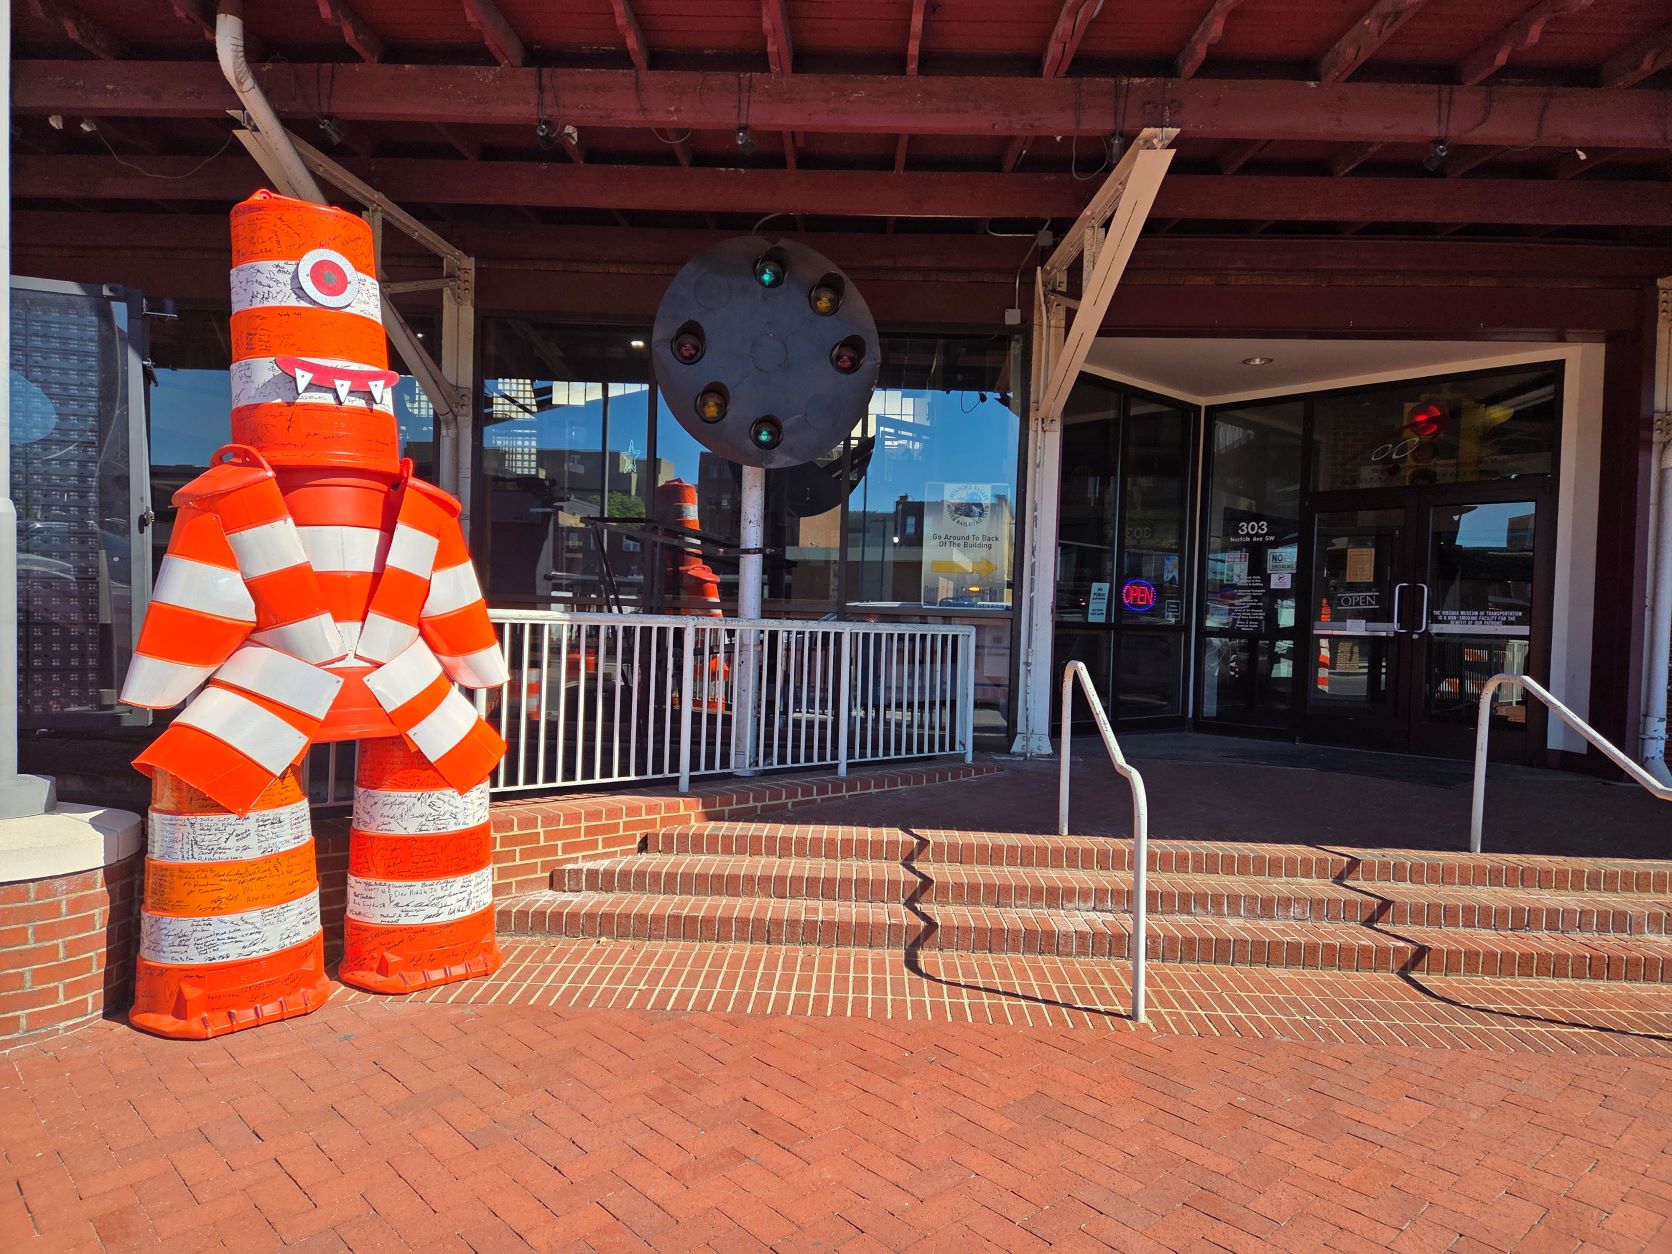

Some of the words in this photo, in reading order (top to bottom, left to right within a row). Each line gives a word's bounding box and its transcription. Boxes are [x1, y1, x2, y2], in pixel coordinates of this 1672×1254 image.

[1238, 521, 1268, 534] 303
[963, 541, 992, 550] Building
[1272, 554, 1283, 562] NO
[1124, 586, 1153, 605] OPEN
[1340, 595, 1376, 606] OPEN
